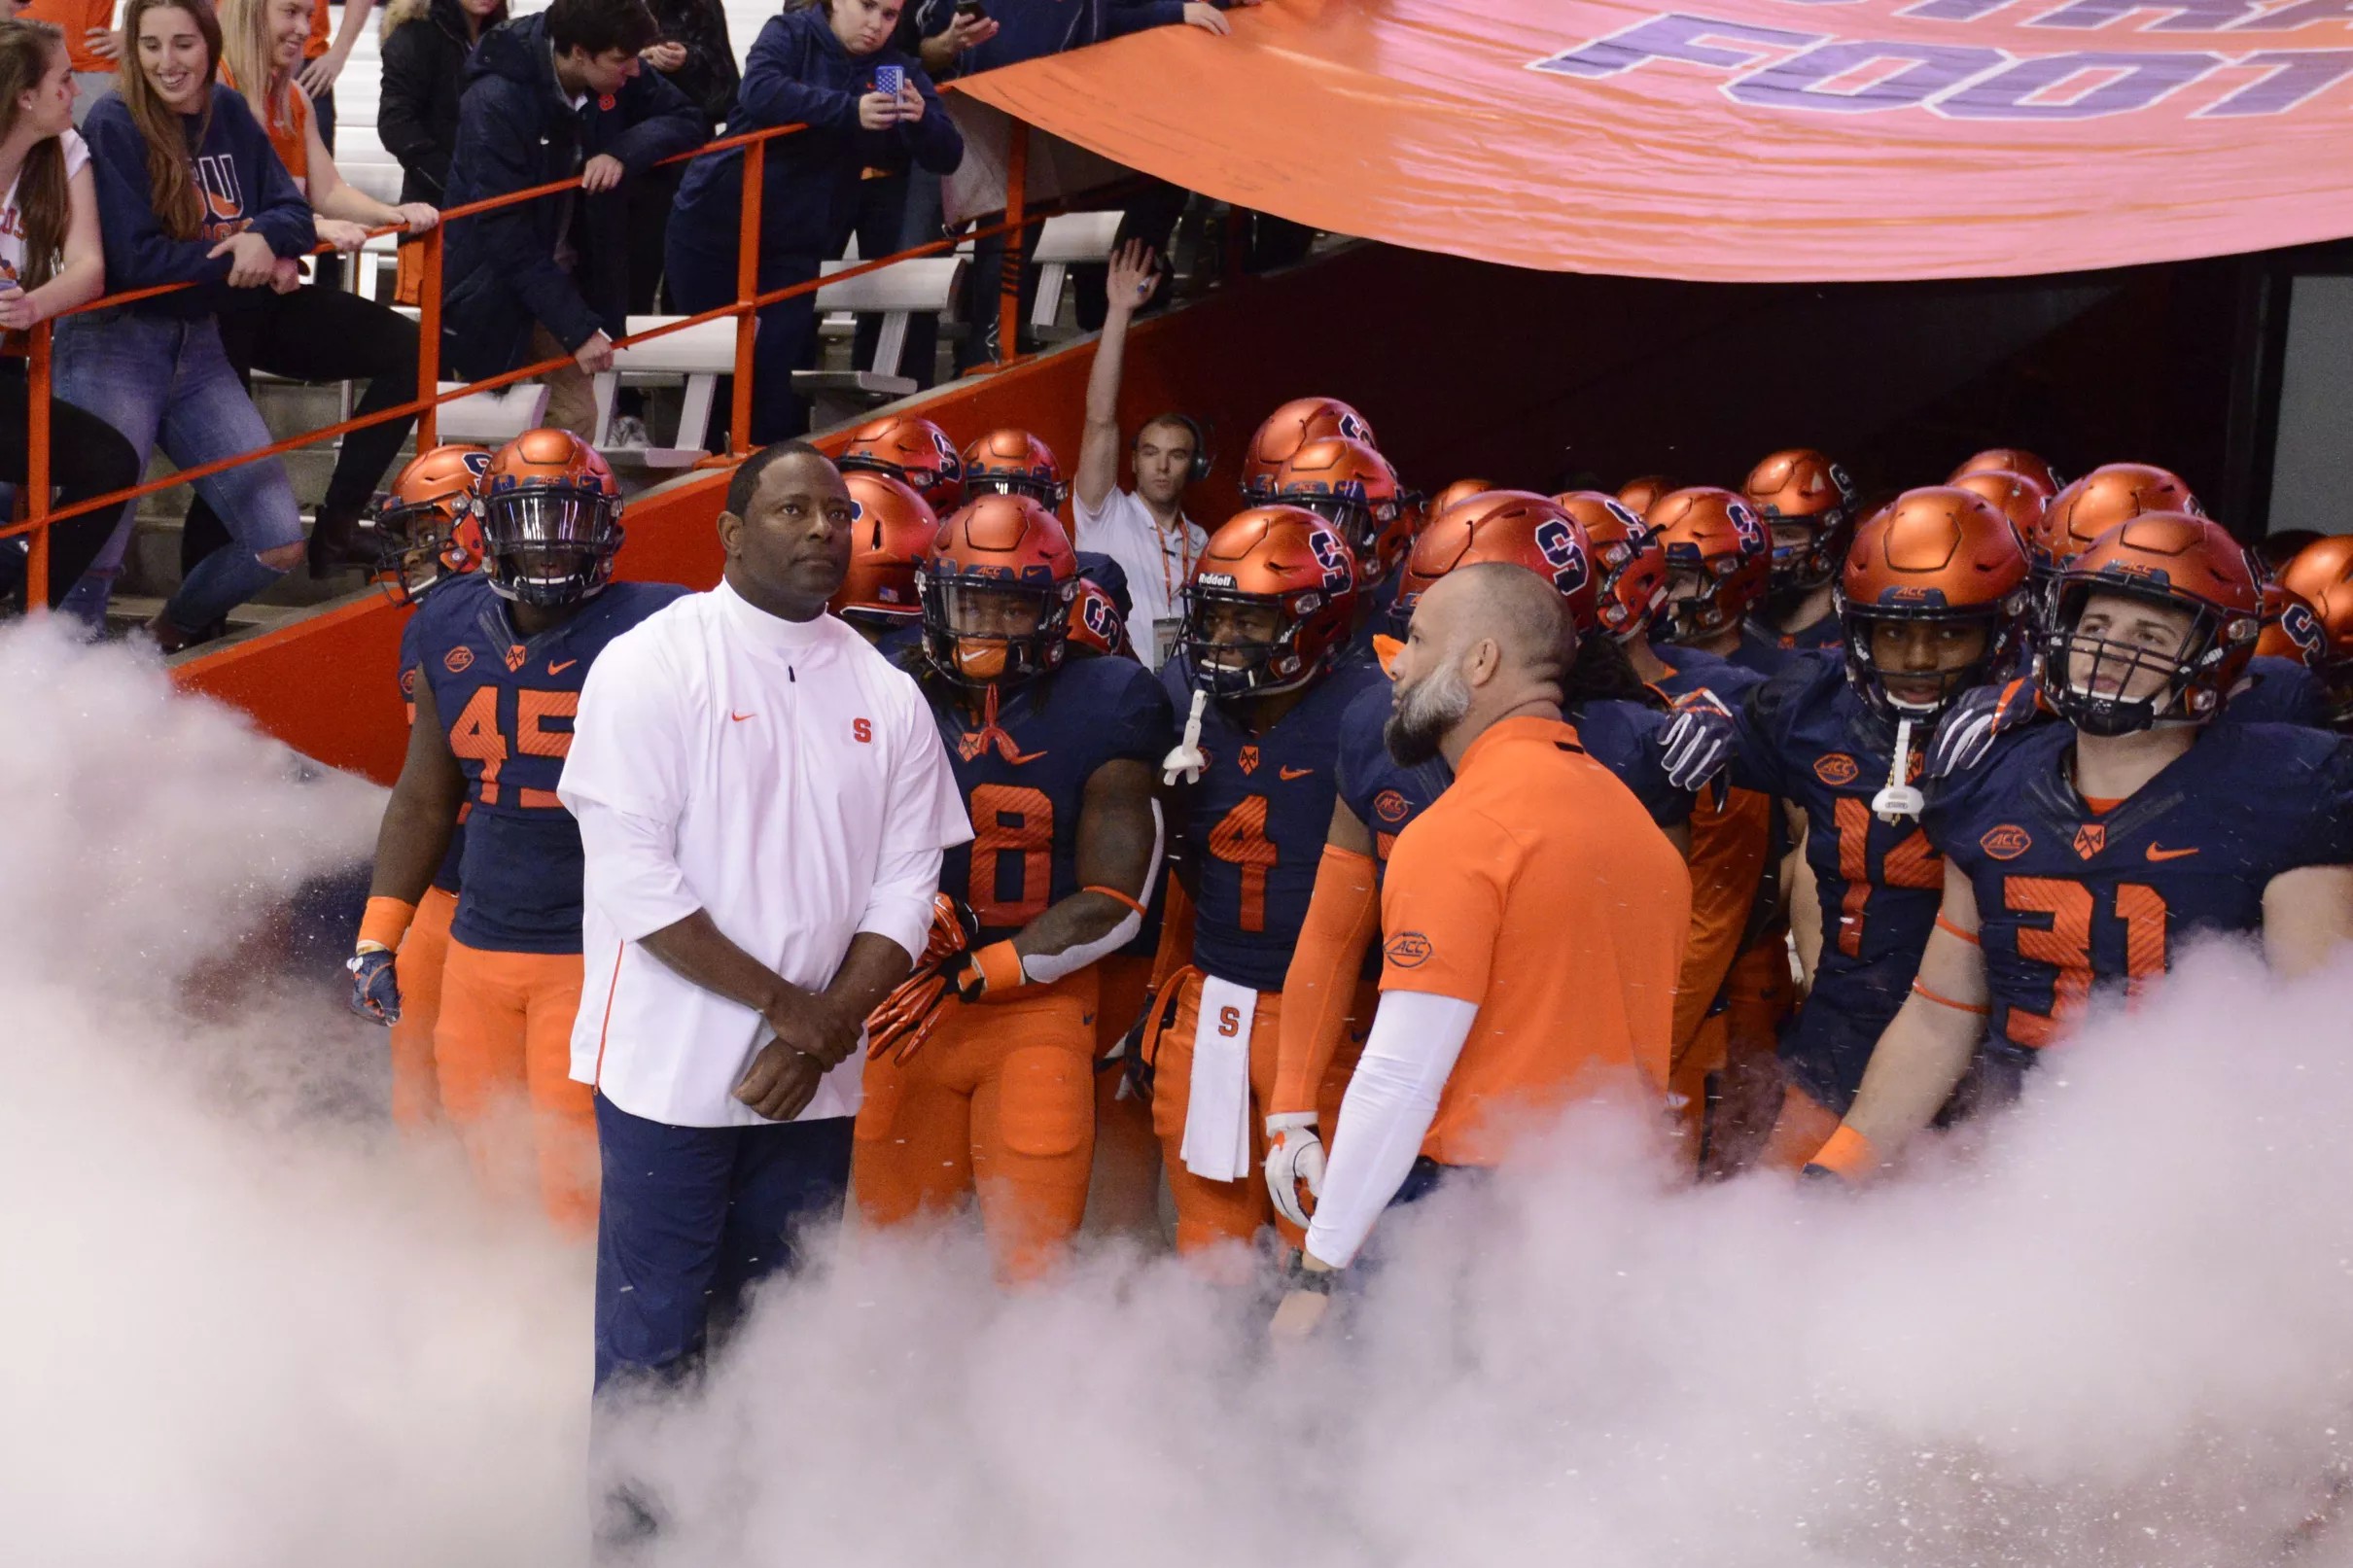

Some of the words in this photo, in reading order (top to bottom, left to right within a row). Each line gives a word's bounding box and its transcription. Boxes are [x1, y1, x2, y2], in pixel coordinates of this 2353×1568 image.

[975, 567, 1002, 576] ACC
[1309, 529, 1353, 598] S
[1535, 518, 1589, 596] S
[1198, 573, 1232, 587] Riddell
[1894, 586, 1927, 599] ACC
[854, 717, 871, 744] S
[450, 685, 579, 808] 45
[1820, 761, 1851, 777] ACC
[968, 782, 1054, 927] 8
[1988, 833, 2021, 848] ACC
[1209, 794, 1278, 932] 4
[1390, 940, 1427, 957] ACC
[2004, 876, 2166, 1050] 31
[1218, 1006, 1240, 1037] S
